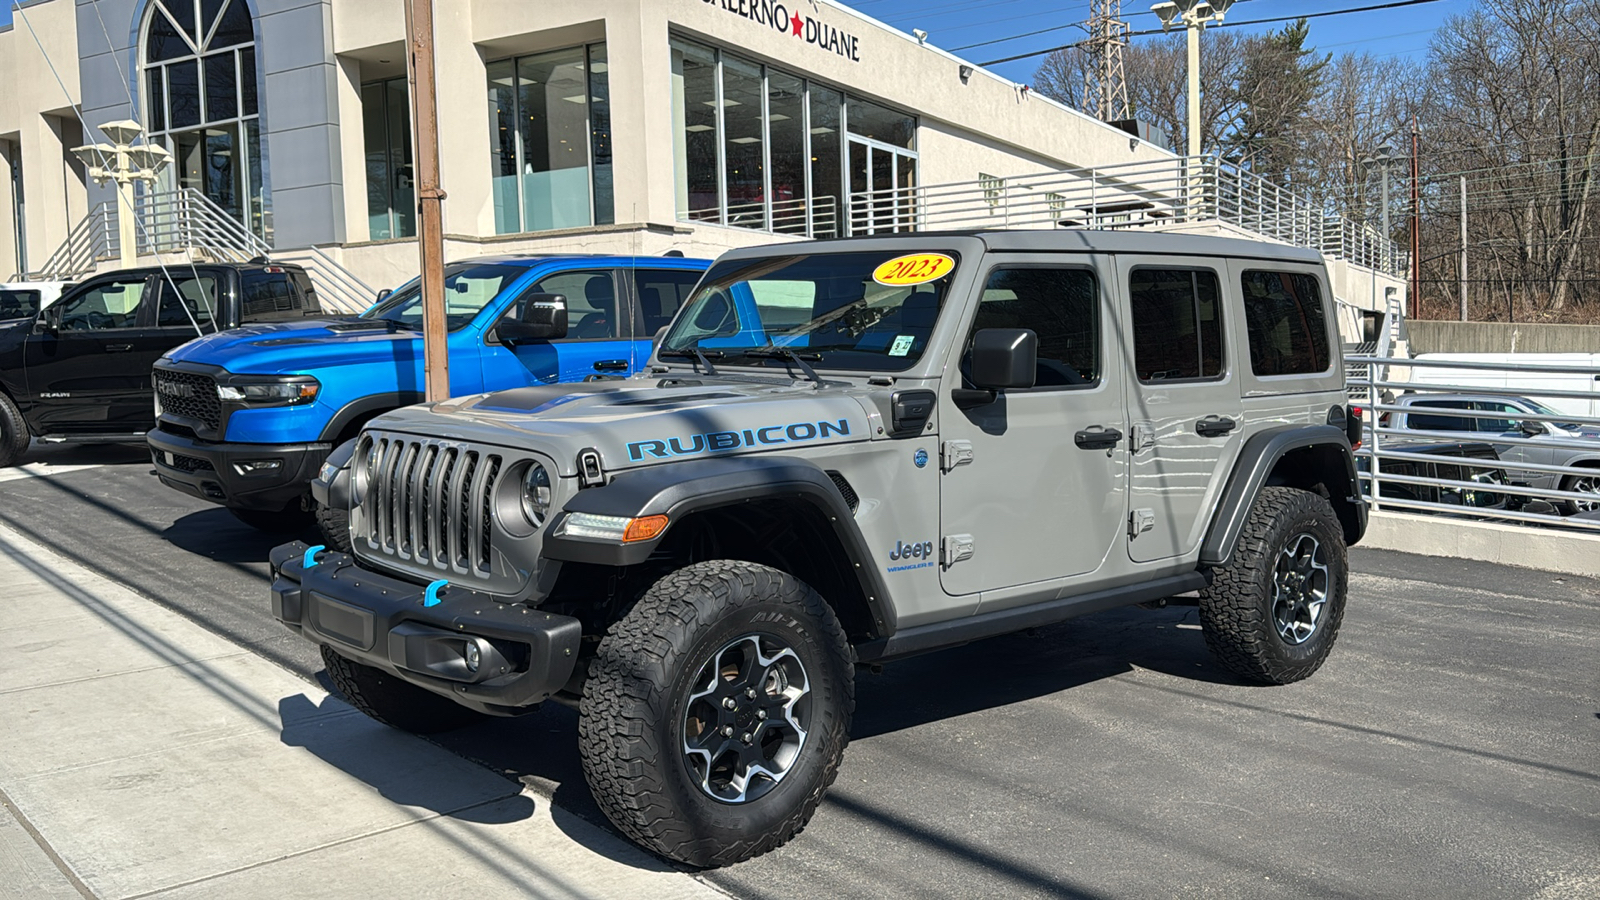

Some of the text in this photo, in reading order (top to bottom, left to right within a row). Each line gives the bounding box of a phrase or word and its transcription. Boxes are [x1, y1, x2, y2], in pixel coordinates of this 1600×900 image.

[702, 0, 860, 62] LERNO DUANE
[882, 258, 943, 280] 2023
[626, 419, 850, 462] RUBICON
[889, 540, 933, 561] Jeep
[887, 562, 927, 573] WRANGLER
